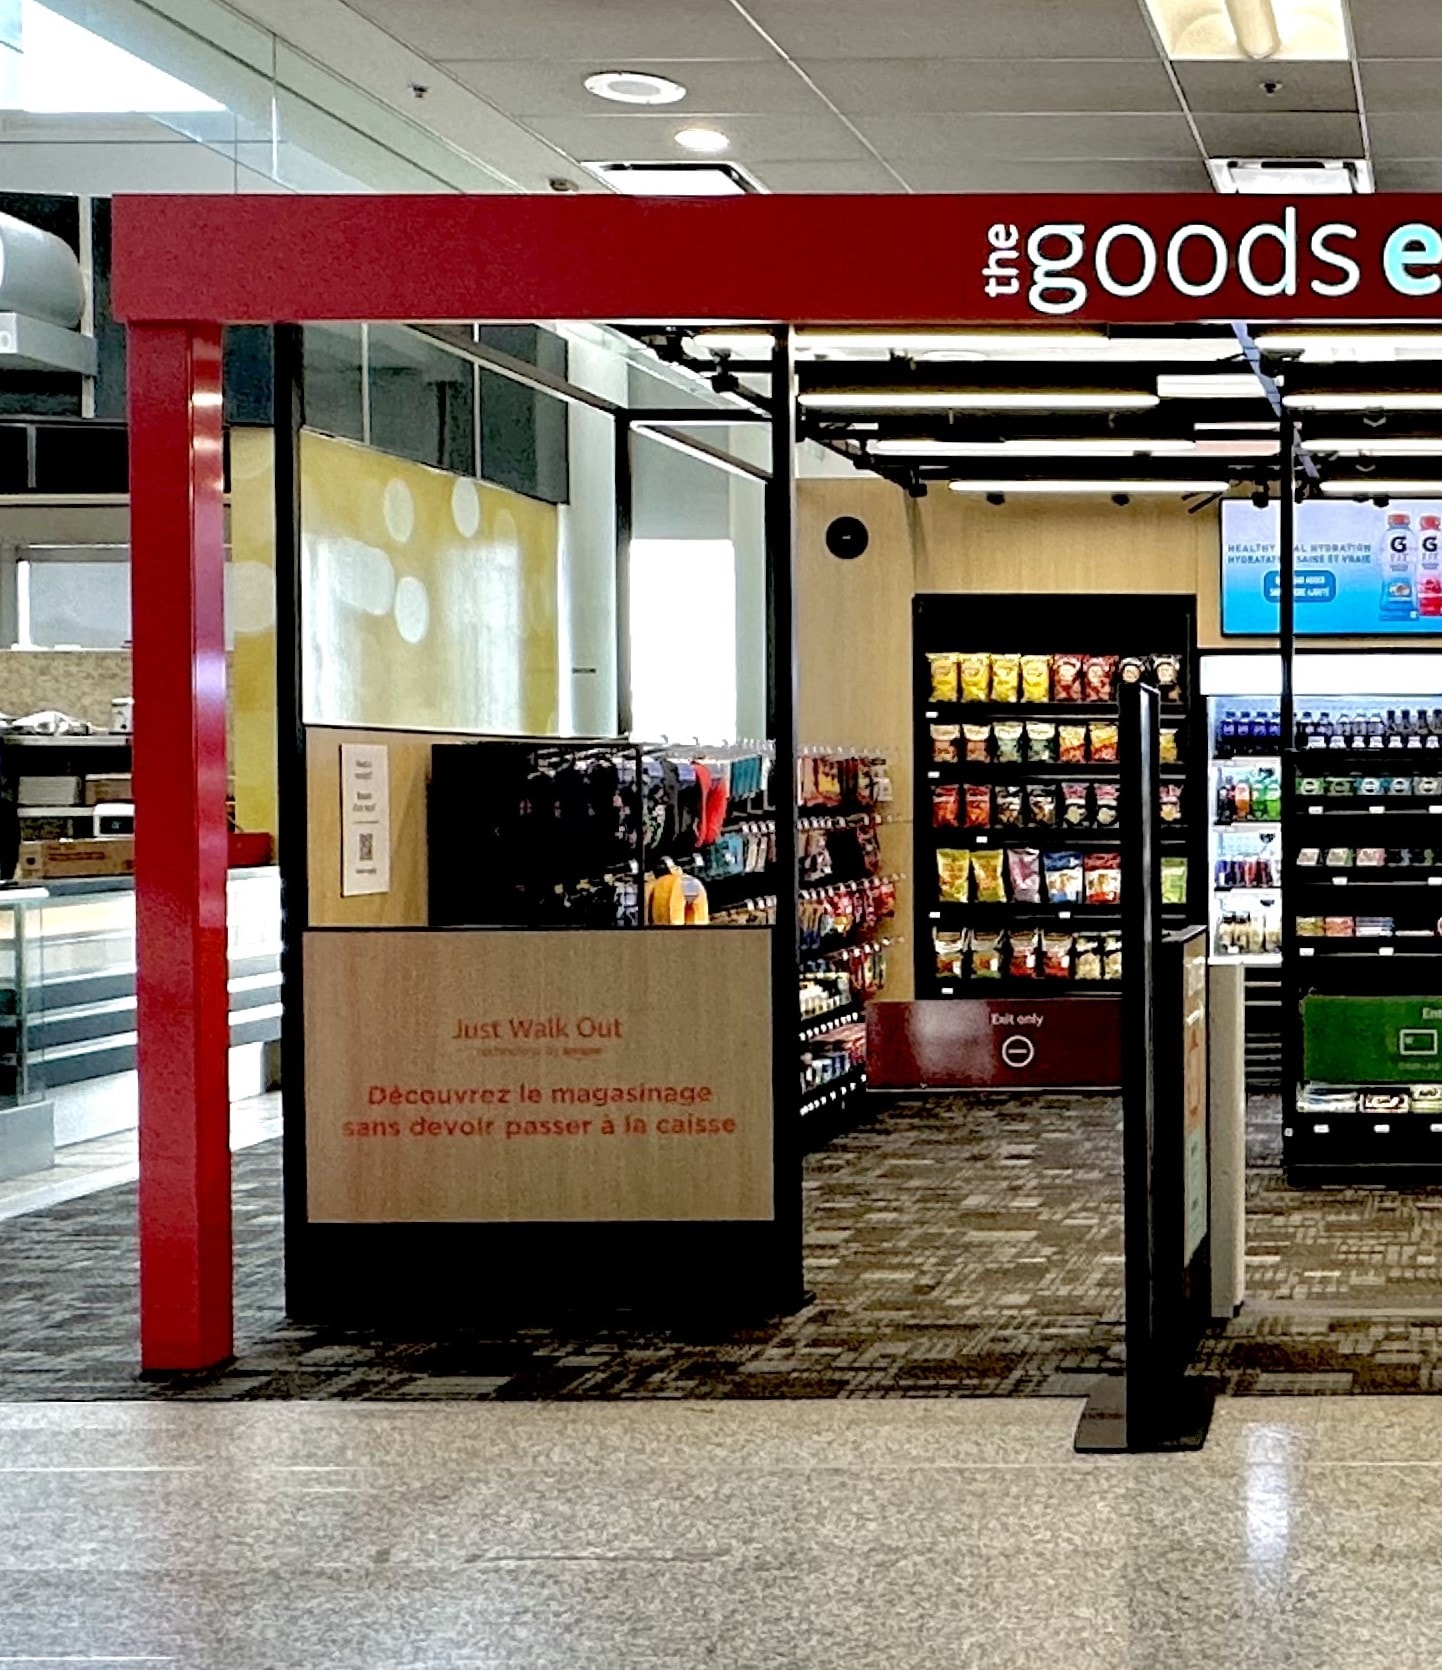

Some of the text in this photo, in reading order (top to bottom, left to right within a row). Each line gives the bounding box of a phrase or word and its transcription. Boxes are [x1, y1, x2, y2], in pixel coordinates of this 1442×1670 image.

[982, 224, 1019, 297] the
[1027, 207, 1359, 315] goods
[1227, 544, 1275, 552] HEALTHY
[1310, 544, 1371, 552] HYDRATION
[1390, 535, 1408, 553] G
[1422, 535, 1439, 553] G
[1296, 555, 1325, 563] SAINE
[1327, 555, 1339, 563] ET
[1342, 555, 1371, 563] VRAIE
[452, 1017, 623, 1039] Just Walk Out
[990, 1012, 1044, 1028] Exit only
[368, 1083, 713, 1107] Découvrez le magasinage
[343, 1113, 737, 1140] sans devoir passer à la caisse
